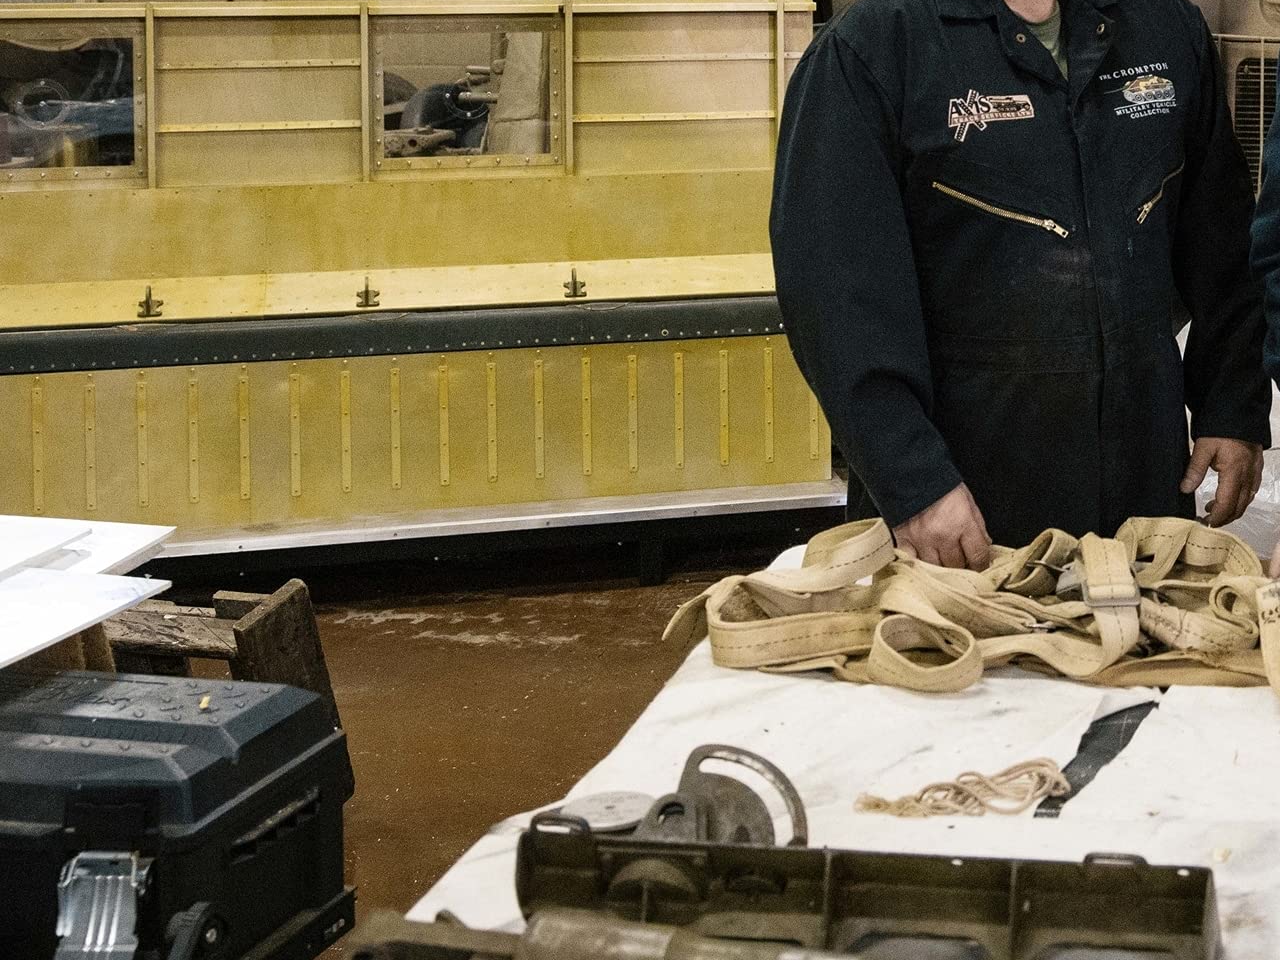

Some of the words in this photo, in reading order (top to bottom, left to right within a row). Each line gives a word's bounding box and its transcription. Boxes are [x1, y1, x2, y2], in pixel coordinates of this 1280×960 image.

[1112, 62, 1169, 79] CROMPTON
[1115, 103, 1151, 116] MILITARY
[1130, 108, 1170, 119] COLLECTION
[953, 114, 980, 124] TRACK
[981, 110, 1016, 120] SERVICES
